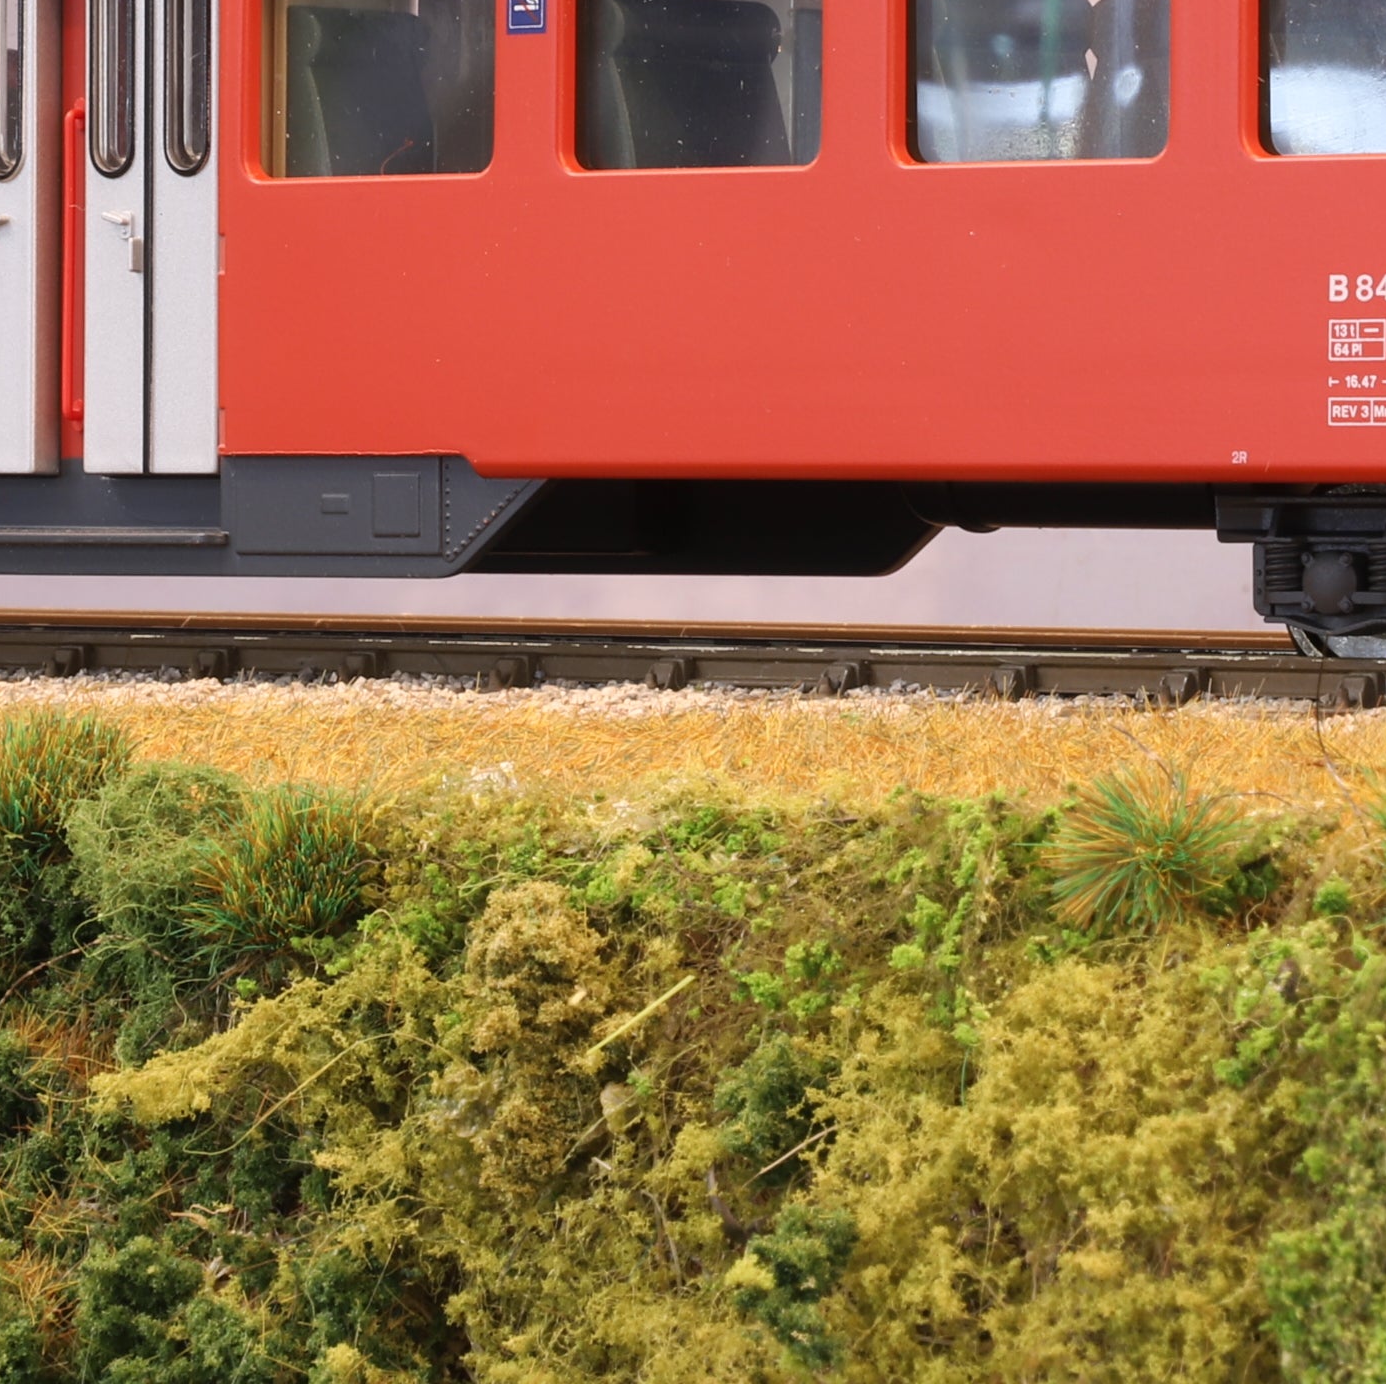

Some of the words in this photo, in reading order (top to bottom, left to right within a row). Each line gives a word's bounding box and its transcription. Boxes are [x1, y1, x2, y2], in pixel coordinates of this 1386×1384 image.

[1328, 274, 1349, 302] B
[1333, 324, 1348, 338] 13
[1333, 343, 1349, 357] 64
[1344, 375, 1378, 388] 16.47
[1331, 405, 1358, 418] REV
[1360, 405, 1370, 418] 3
[1231, 450, 1248, 464] 2R
